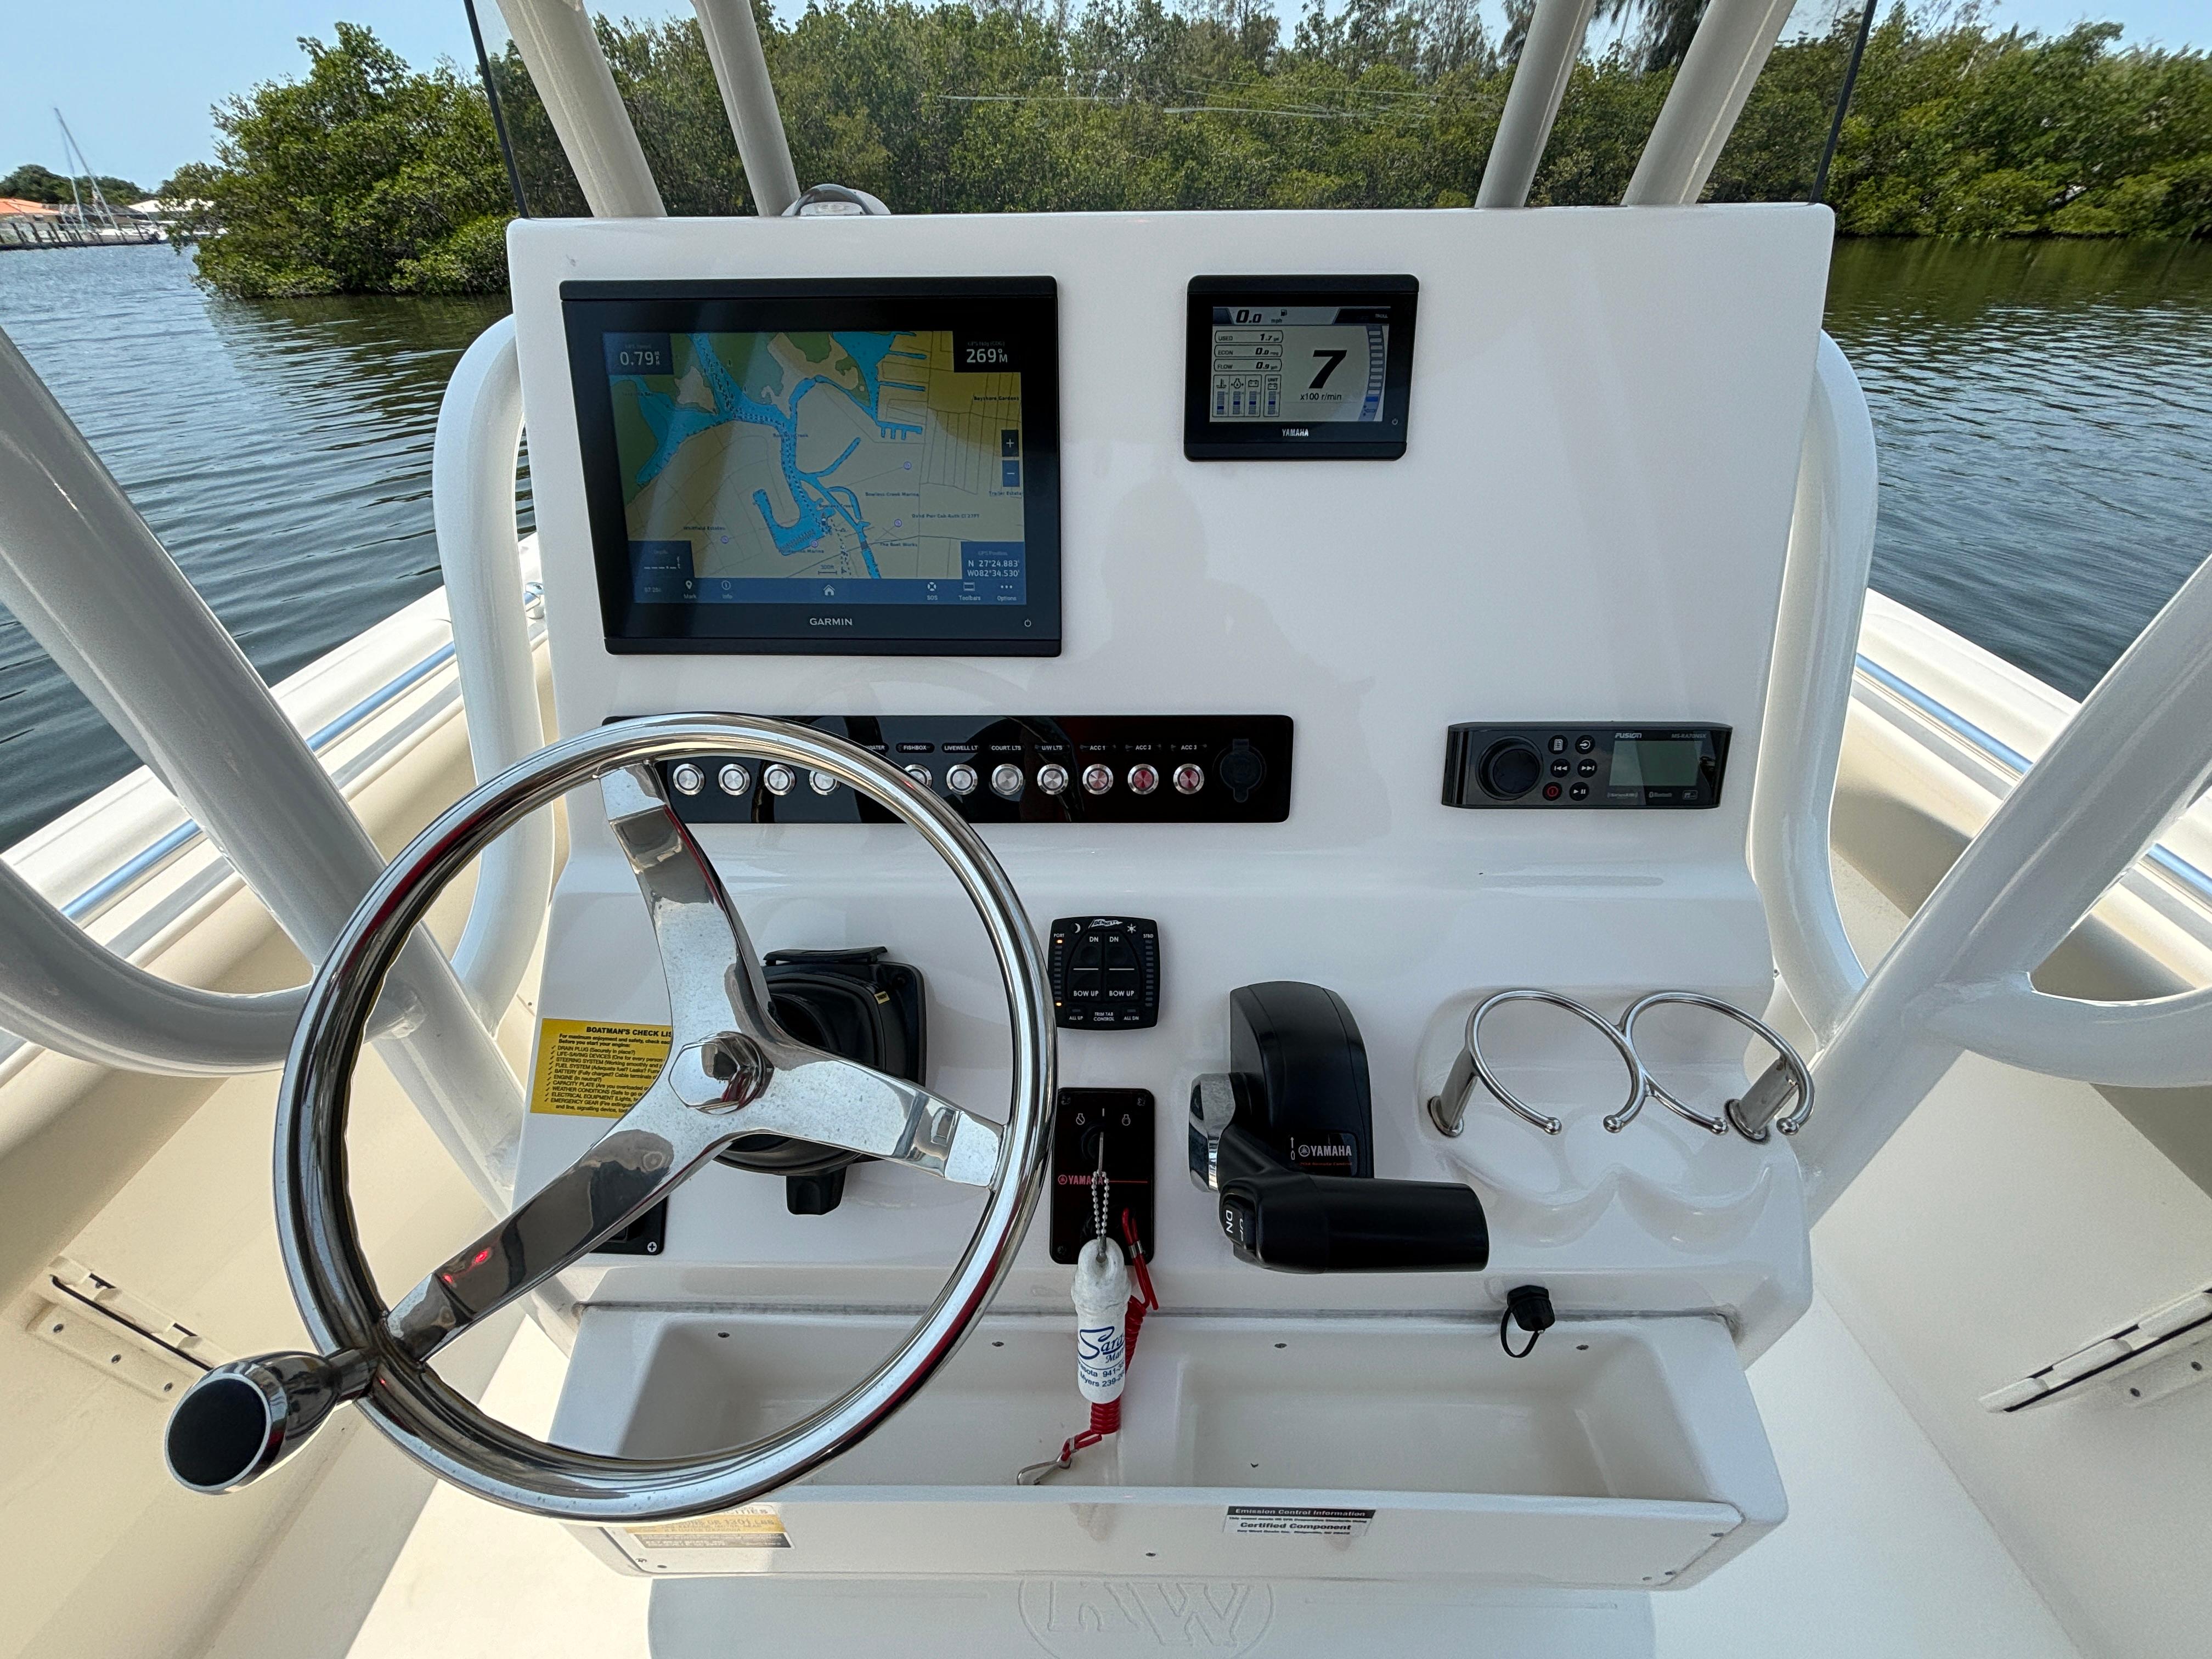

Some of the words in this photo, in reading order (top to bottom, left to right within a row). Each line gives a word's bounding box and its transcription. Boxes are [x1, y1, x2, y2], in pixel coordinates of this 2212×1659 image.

[1235, 309, 1262, 324] 0.0
[619, 351, 654, 365] 0.79
[1309, 349, 1347, 389] 7
[1282, 428, 1309, 437] YAMAHA
[809, 618, 853, 626] GARMIN
[586, 1026, 630, 1035] BOATMAN'S
[1310, 1145, 1352, 1156] YAMAHA
[1226, 1210, 1233, 1234] DN
